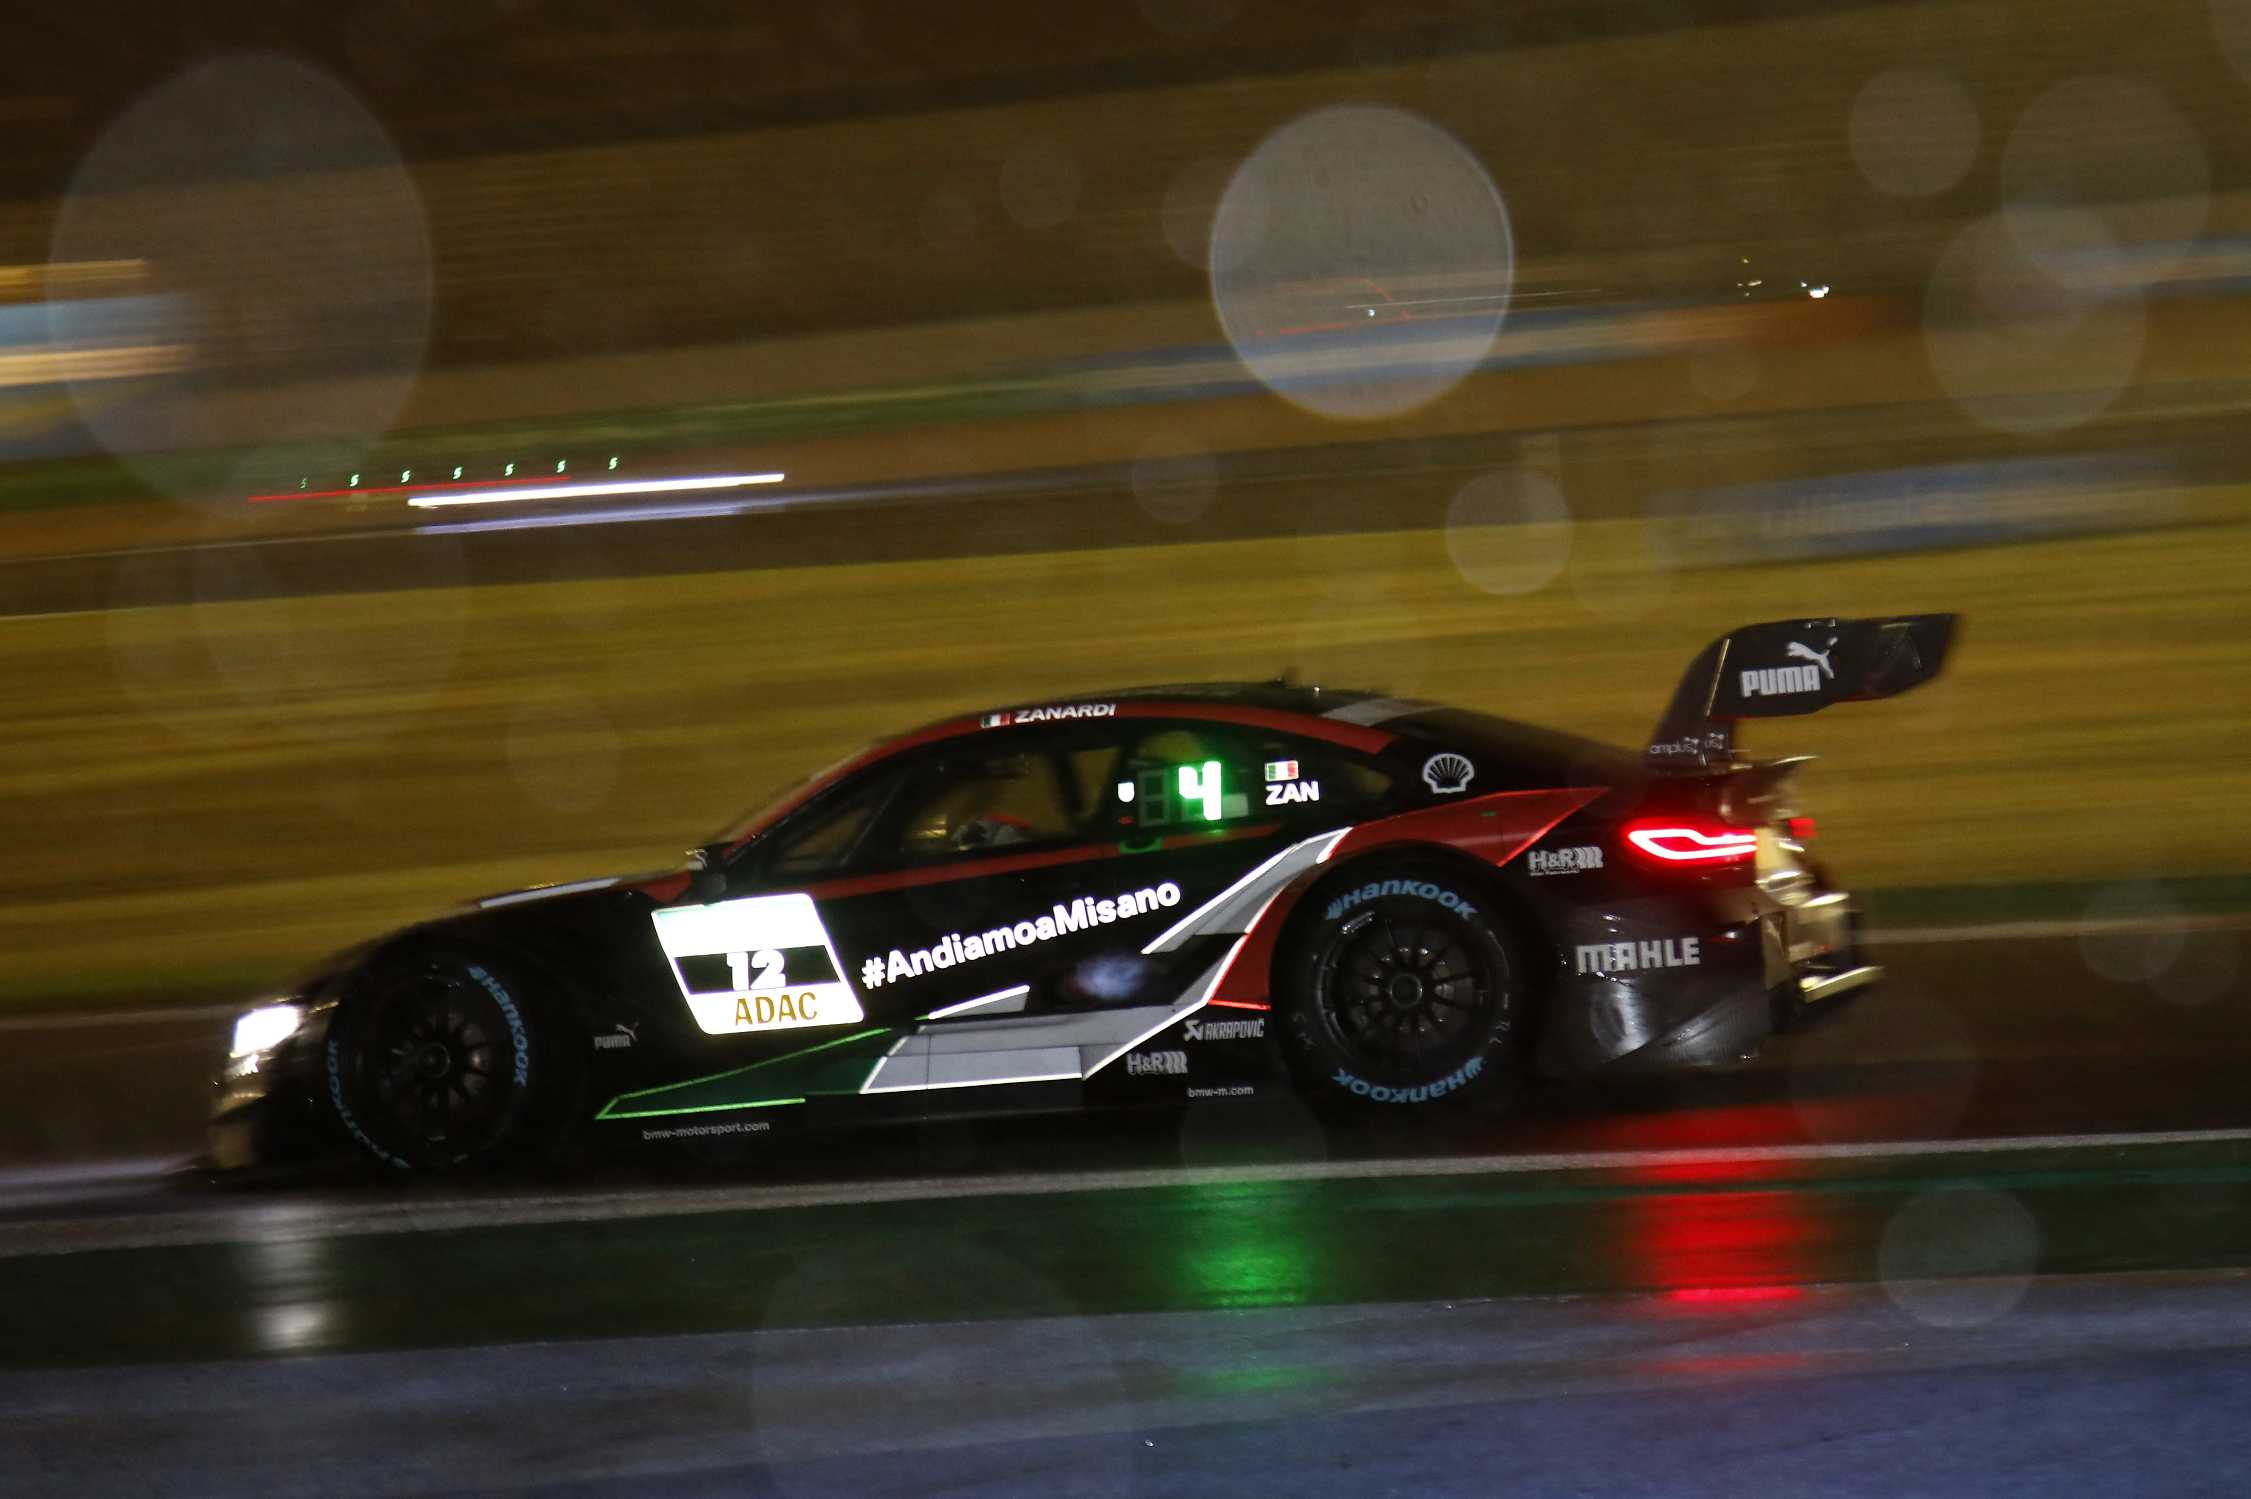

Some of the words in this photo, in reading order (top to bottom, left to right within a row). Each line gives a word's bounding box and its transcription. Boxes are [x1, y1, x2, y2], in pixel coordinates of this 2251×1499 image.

[1740, 665, 1821, 697] PUMA
[1015, 704, 1116, 724] ZANARDI
[1178, 761, 1222, 820] 4
[1266, 781, 1319, 805] ZAN
[862, 882, 1181, 989] #AndiamoaMisano
[726, 949, 786, 991] 12
[1576, 937, 1700, 974] MAHLE
[735, 992, 818, 1026] ADAC
[1187, 1086, 1254, 1097] bmw-m.com
[643, 1121, 770, 1140] bmw-motorsport.com
